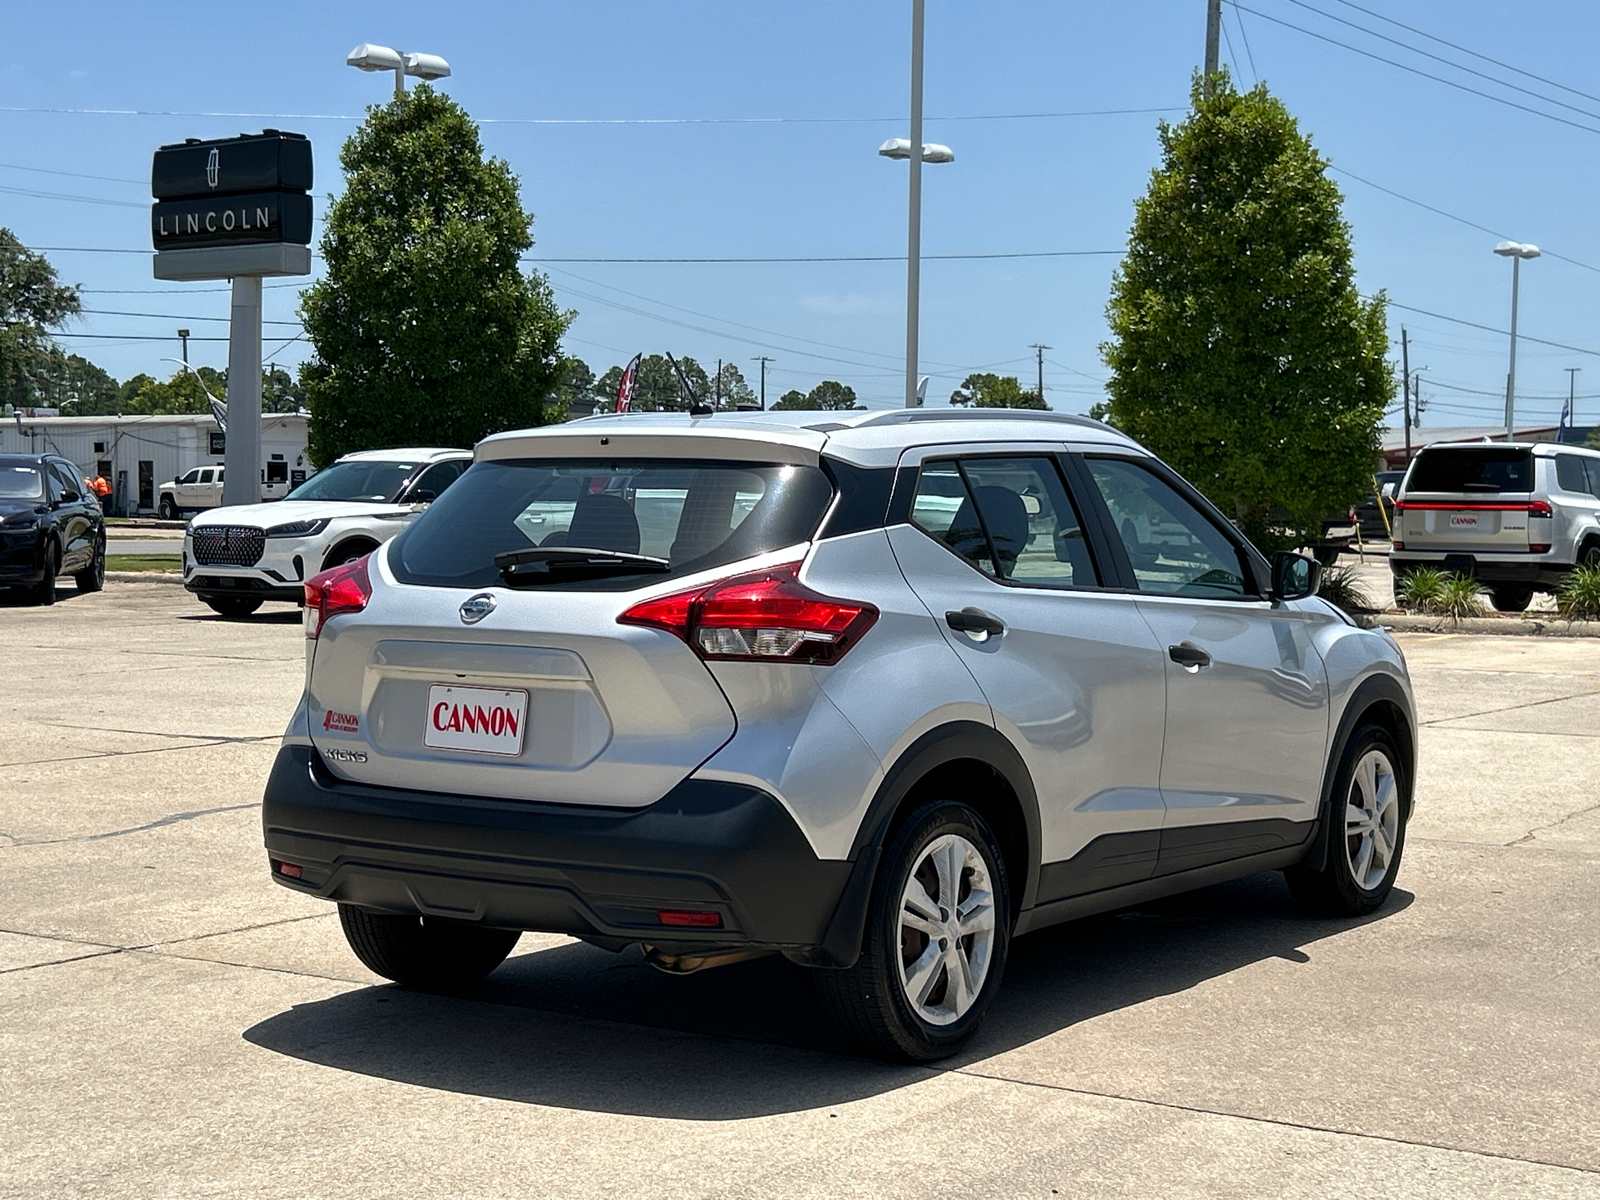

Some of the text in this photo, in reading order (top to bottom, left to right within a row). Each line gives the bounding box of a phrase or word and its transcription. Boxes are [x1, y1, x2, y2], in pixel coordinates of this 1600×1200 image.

[159, 206, 269, 236] LINCOLN
[1451, 516, 1477, 525] CANNON
[332, 712, 360, 726] CANNON
[433, 701, 520, 738] CANNON
[324, 747, 368, 763] KICKS
